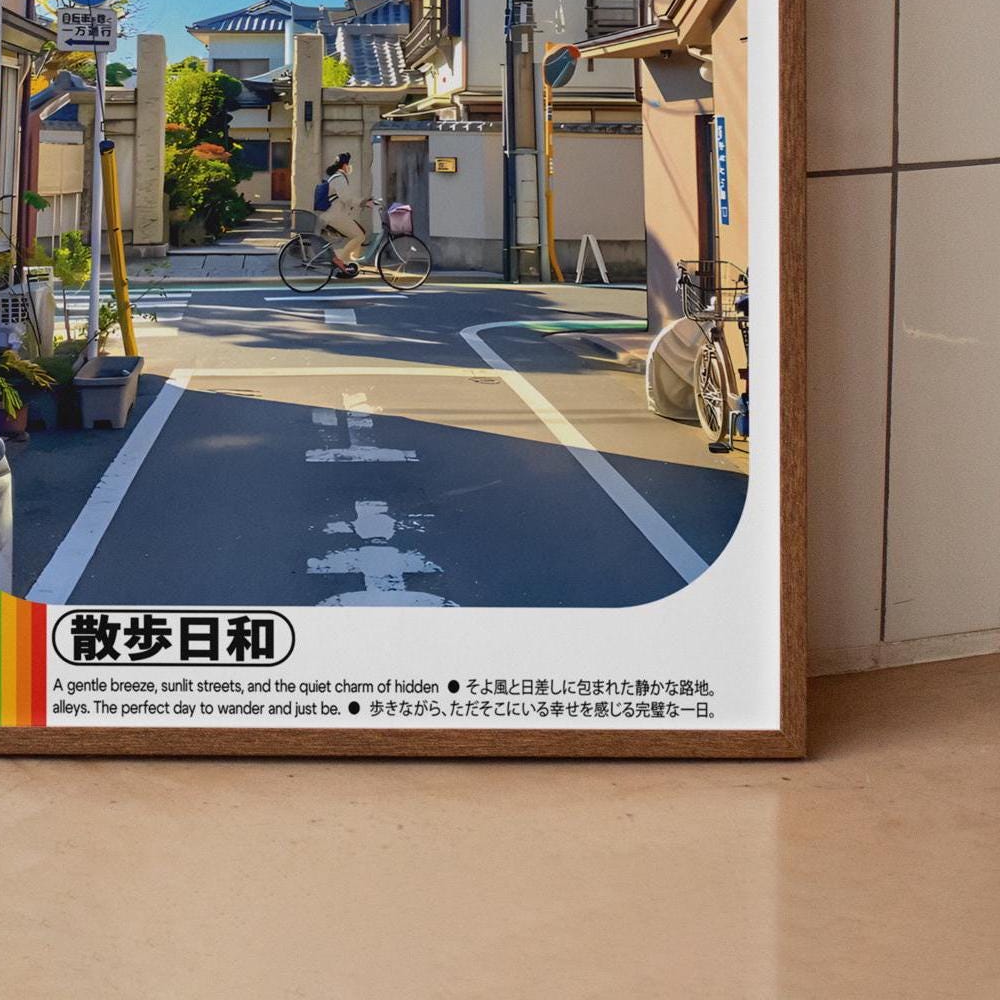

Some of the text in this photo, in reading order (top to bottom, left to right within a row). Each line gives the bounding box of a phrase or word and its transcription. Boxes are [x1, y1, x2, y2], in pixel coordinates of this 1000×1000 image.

[71, 613, 275, 662] 散歩日和
[53, 678, 439, 696] A gentle breeze, sunlit streets, and the quiet charm of hidden
[467, 679, 715, 697] そよ風と日差しに包まれた静かな路地。
[53, 700, 341, 718] alleys. The perfect day to wander and just be.
[370, 700, 715, 718] 歩きながら、ただそこにいる幸せを感じる完璧な一日。
